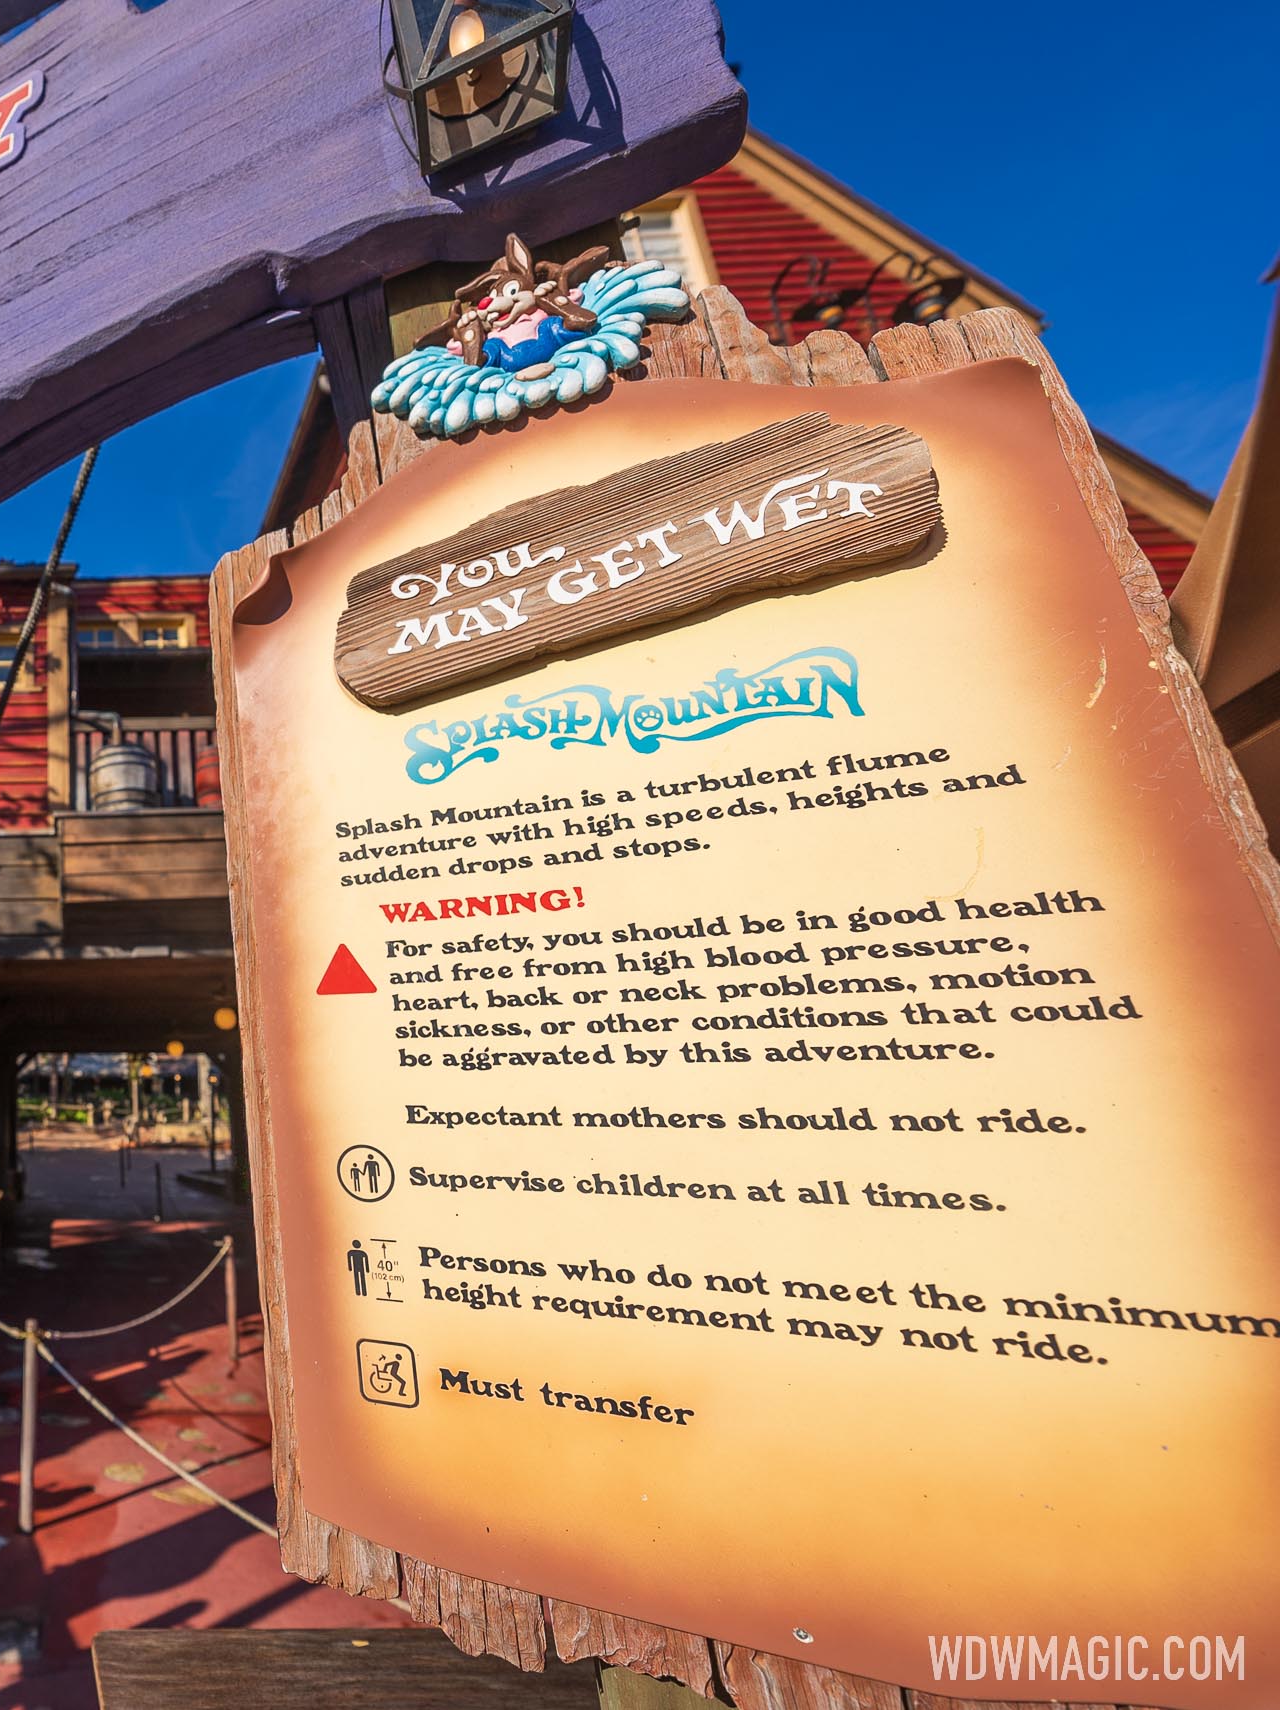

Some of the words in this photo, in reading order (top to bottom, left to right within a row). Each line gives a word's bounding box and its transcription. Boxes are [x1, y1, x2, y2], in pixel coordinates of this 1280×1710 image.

[386, 588, 529, 656] MAY
[546, 519, 685, 606] GET
[685, 467, 885, 546] WET
[404, 703, 592, 785] SPLASH
[507, 646, 867, 755] MOUNTAIN
[335, 813, 423, 840] Splash
[430, 794, 574, 827] Mountain
[580, 789, 606, 808] is
[616, 790, 636, 803] a
[643, 759, 817, 799] turbulent
[826, 748, 951, 776] flume
[338, 835, 477, 863] adventure
[485, 822, 555, 846] with
[562, 812, 636, 838] high
[645, 796, 778, 829] speeds,
[785, 778, 929, 811] heights
[942, 763, 1027, 793] and
[340, 864, 441, 887] sudden
[448, 855, 534, 876] drops
[543, 842, 605, 866] and
[612, 837, 711, 859] stops.
[380, 886, 586, 923] WARNING!
[385, 939, 433, 959] For
[441, 931, 534, 955] safety,
[541, 931, 604, 951] you
[611, 915, 732, 944] should
[739, 914, 785, 935] be
[795, 910, 839, 931] in
[847, 900, 946, 933] good
[954, 889, 1106, 920] health
[389, 964, 444, 985] and
[450, 962, 514, 982] free
[522, 958, 607, 978] from
[615, 949, 695, 976] high
[703, 941, 811, 968] blood
[820, 936, 1030, 966] pressure,
[391, 990, 479, 1012] heart,
[485, 985, 564, 1008] back
[572, 989, 609, 1005] or
[619, 978, 707, 1003] neck
[716, 972, 918, 1003] problems,
[928, 963, 1096, 990] motion
[395, 1018, 532, 1039] sickness,
[540, 1020, 576, 1036] or
[586, 1012, 680, 1034] other
[691, 1006, 889, 1031] conditions
[899, 1000, 997, 1025] that
[1010, 994, 1144, 1023] could
[398, 1048, 433, 1068] be
[442, 1043, 616, 1072] aggravated
[623, 1043, 669, 1068] by
[678, 1041, 752, 1064] this
[764, 1037, 995, 1063] adventure.
[404, 1104, 563, 1129] Expectant
[572, 1106, 727, 1129] mothers
[737, 1106, 878, 1131] should
[888, 1107, 964, 1133] not
[976, 1108, 1087, 1134] ride.
[409, 1166, 565, 1193] Supervise
[576, 1172, 737, 1201] children
[746, 1178, 786, 1203] at
[797, 1180, 850, 1206] all
[861, 1182, 1007, 1212] times.
[417, 1245, 547, 1278] Persons
[556, 1259, 636, 1285] who
[647, 1263, 693, 1289] do
[703, 1271, 770, 1296] not
[781, 1280, 898, 1306] meet
[908, 1282, 986, 1313] the
[1002, 1292, 1280, 1339] minimum
[421, 1278, 522, 1310] height
[531, 1295, 775, 1333] requirement
[786, 1318, 884, 1347] may
[899, 1326, 979, 1353] not
[991, 1330, 1108, 1365] ride.
[439, 1367, 525, 1402] Must
[539, 1382, 695, 1426] transfer
